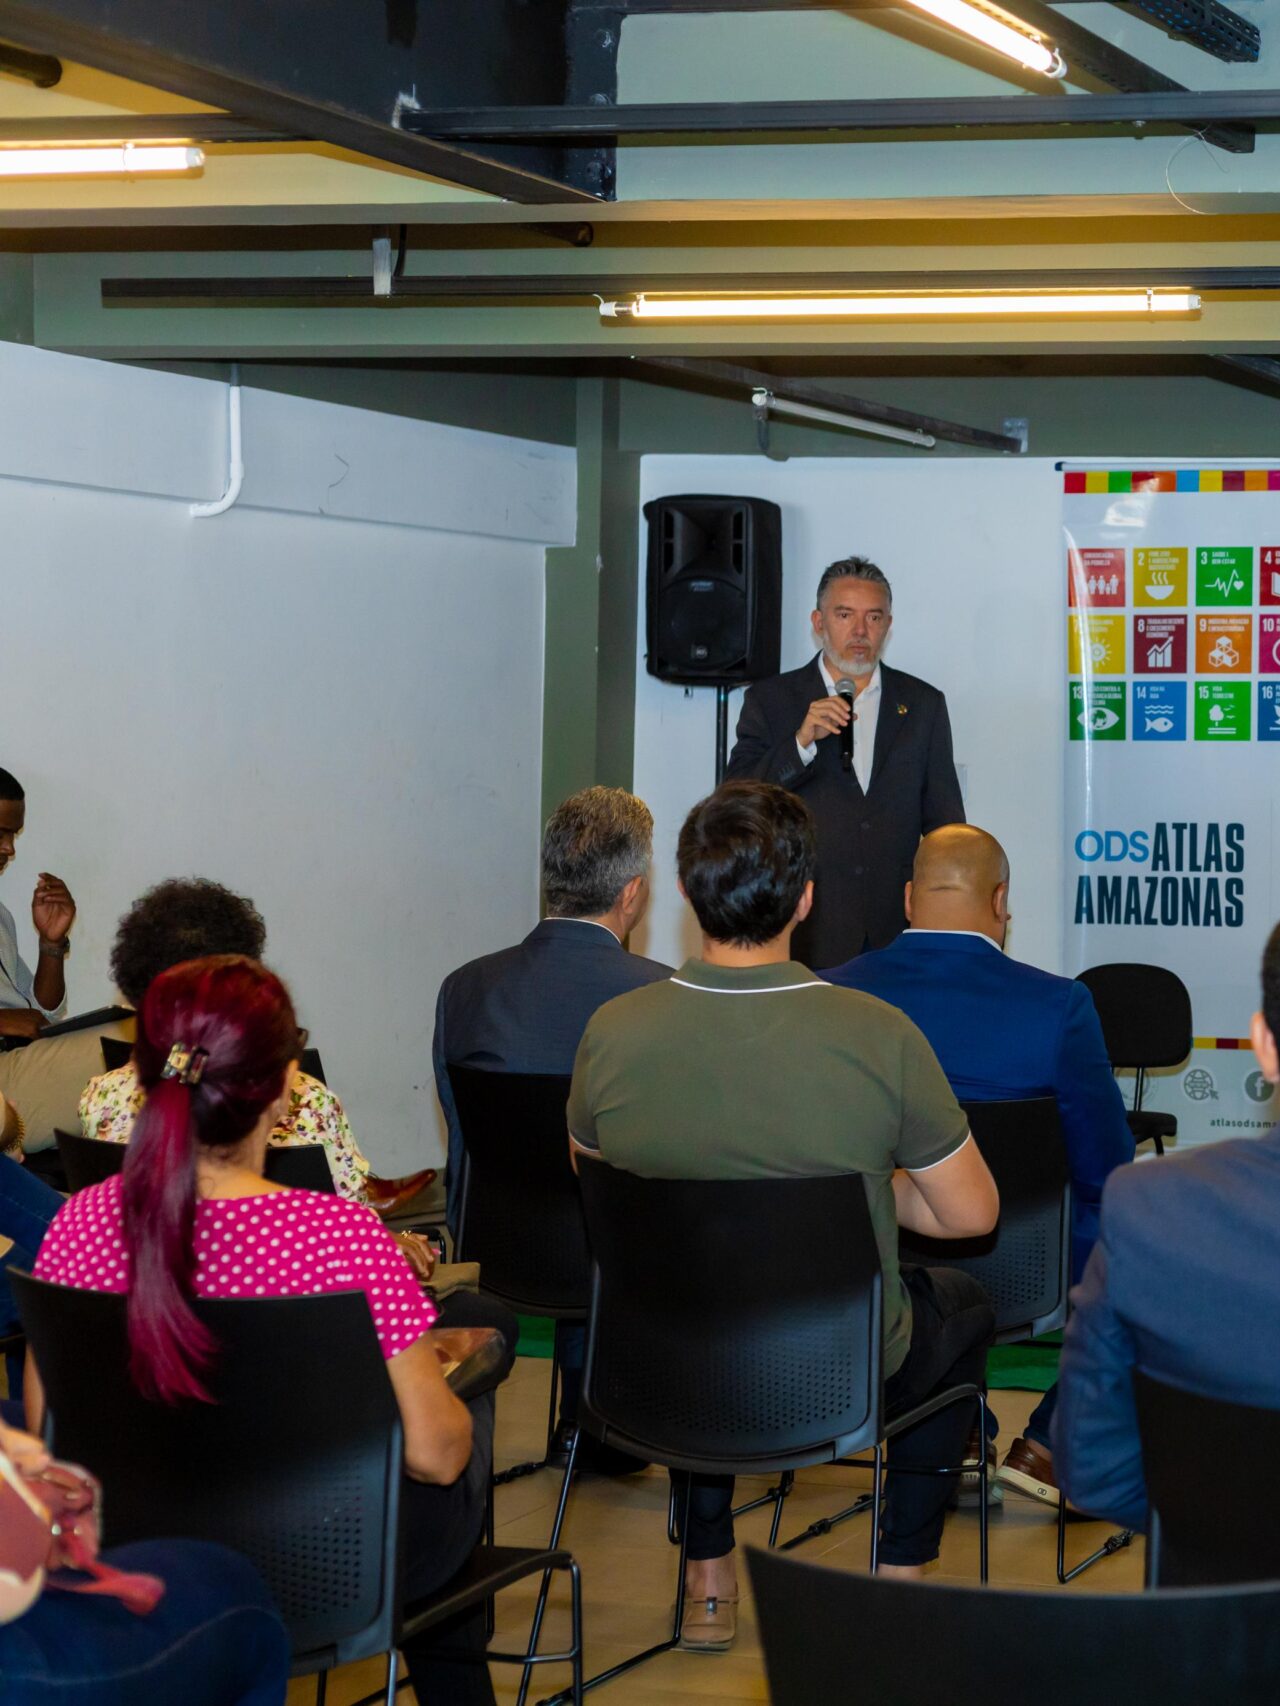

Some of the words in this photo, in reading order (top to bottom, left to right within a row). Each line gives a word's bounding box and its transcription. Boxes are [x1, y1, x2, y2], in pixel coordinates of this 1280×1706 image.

[1138, 552, 1145, 566] 2
[1201, 551, 1208, 565] 3
[1264, 551, 1272, 565] 4
[1138, 619, 1145, 633] 8
[1200, 619, 1207, 632] 9
[1262, 618, 1274, 632] 10
[1136, 686, 1147, 699] 14
[1199, 686, 1209, 699] 15
[1262, 685, 1273, 699] 16
[1074, 875, 1244, 927] AMAZONAS
